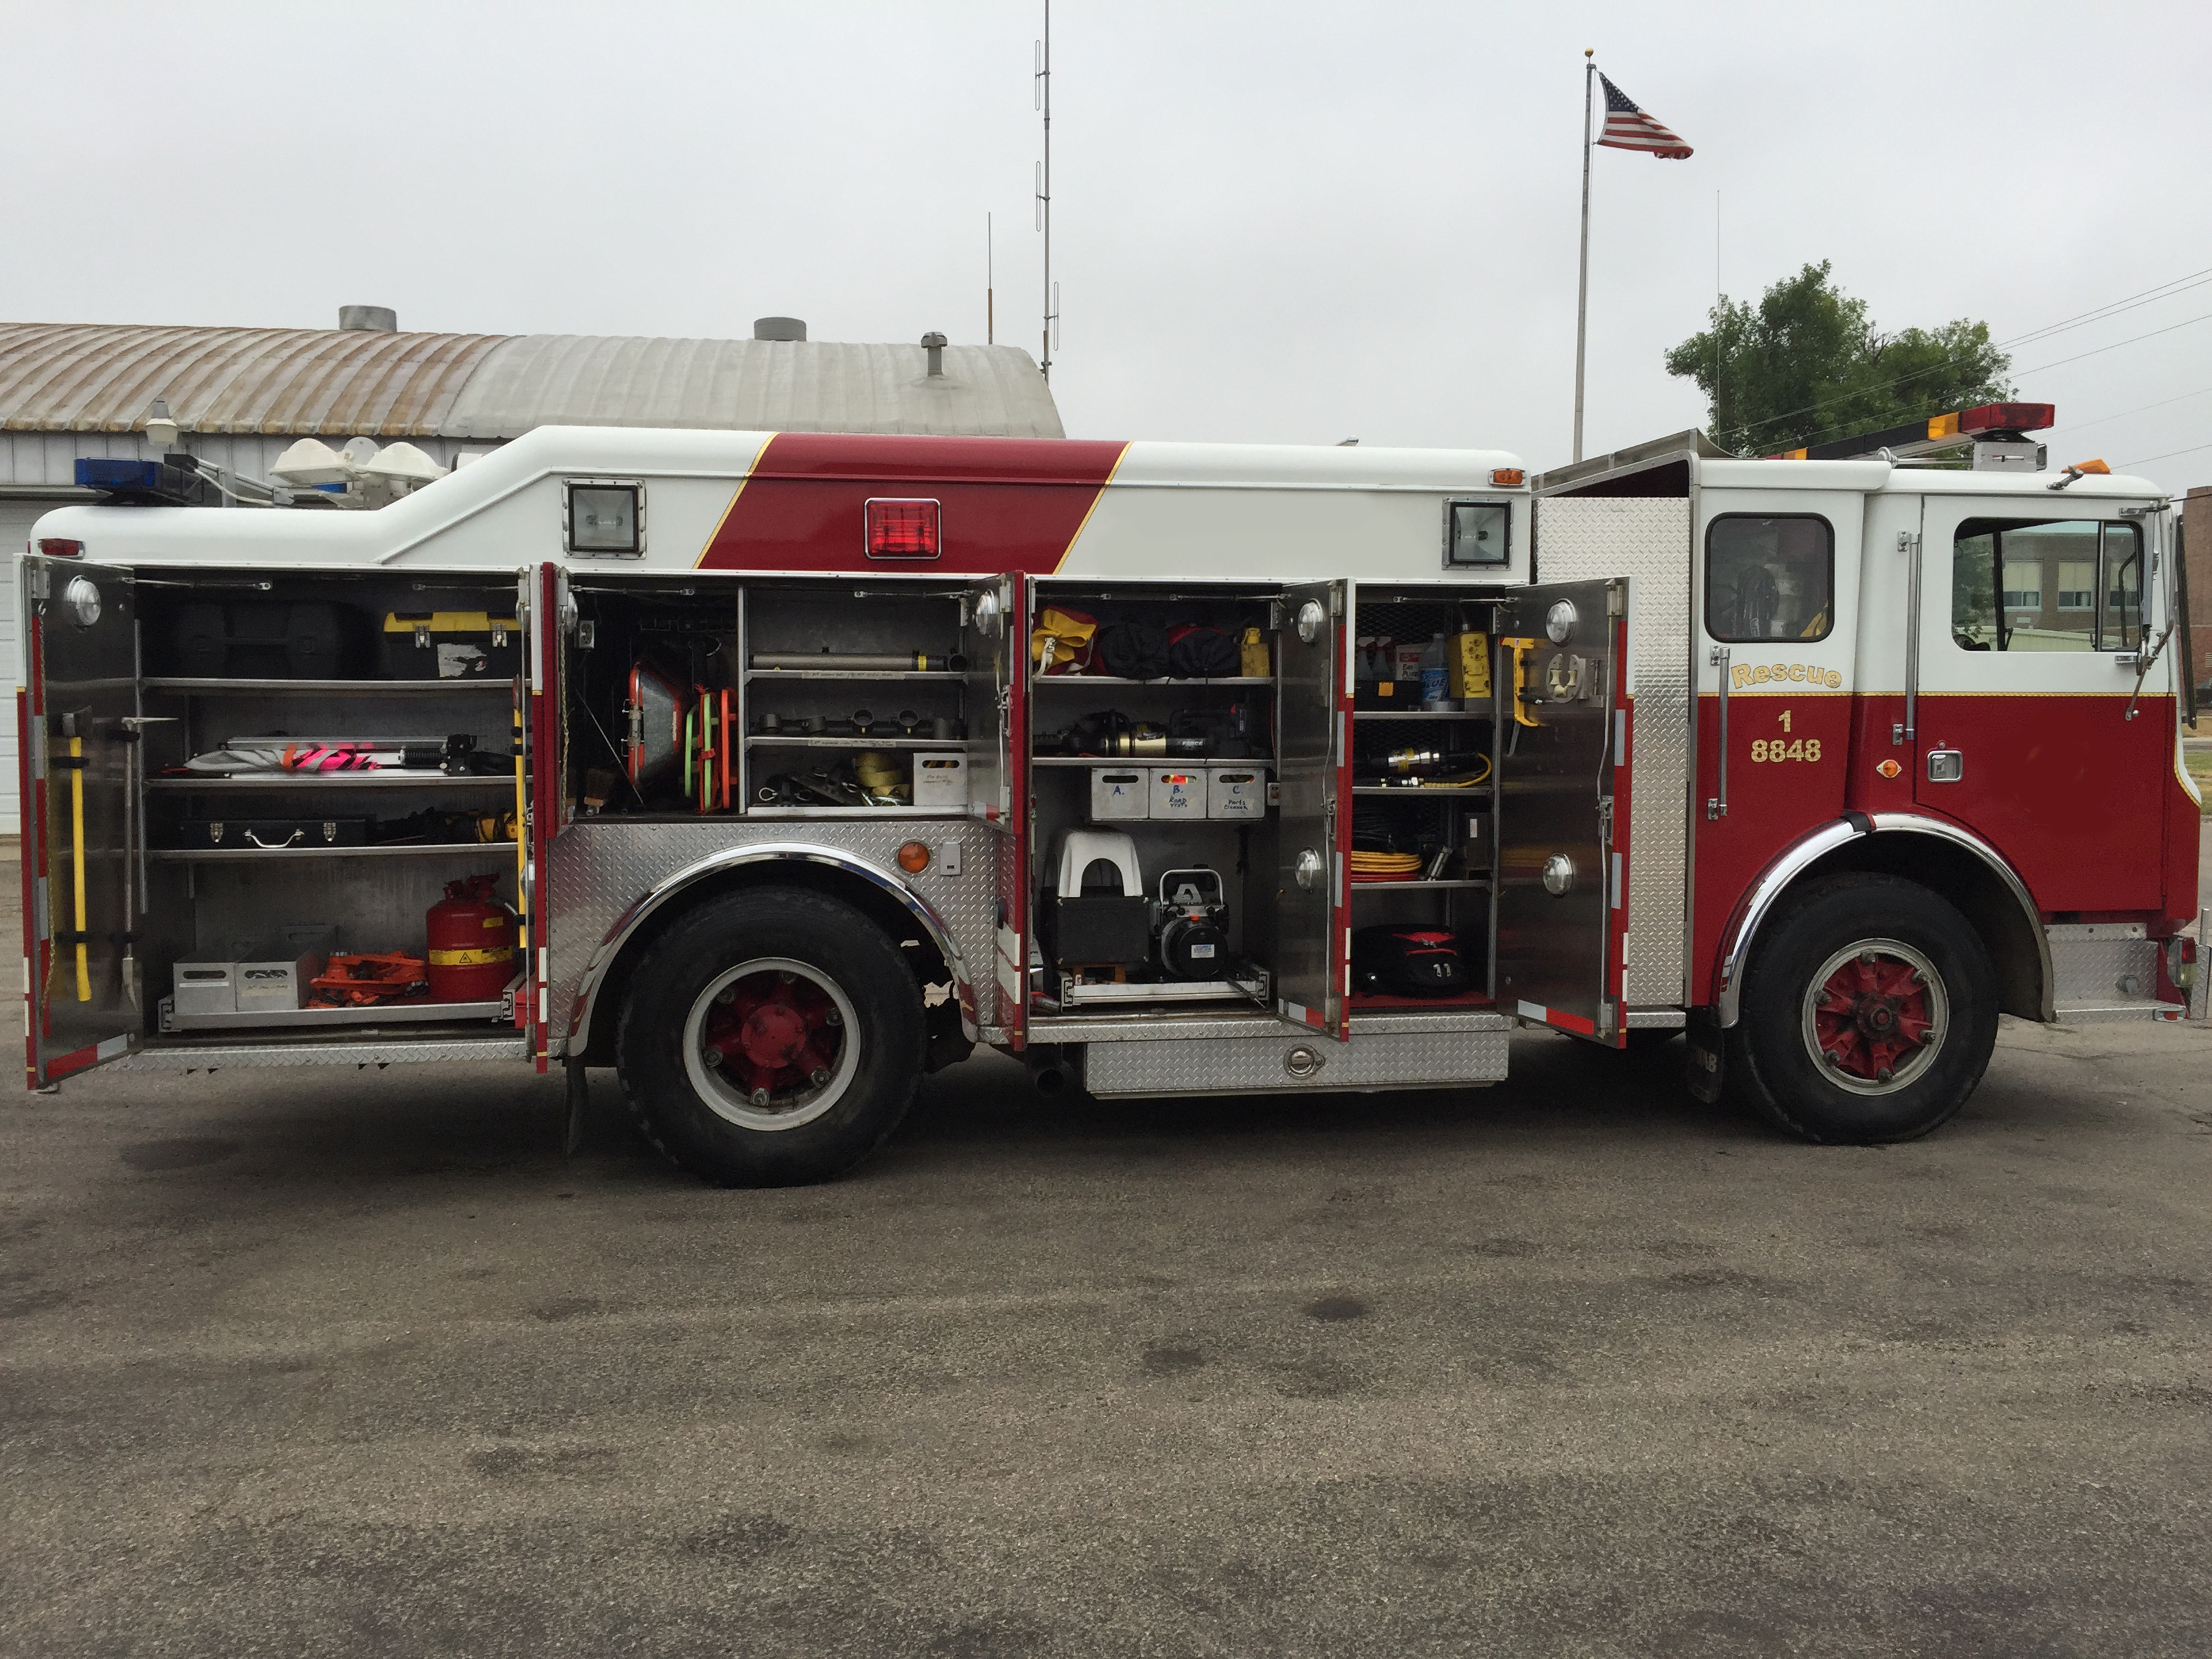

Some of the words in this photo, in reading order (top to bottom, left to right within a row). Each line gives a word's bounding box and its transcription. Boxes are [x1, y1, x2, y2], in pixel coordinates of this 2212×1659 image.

[1730, 663, 1842, 689] Rescue
[1778, 710, 1791, 733] 1
[1750, 739, 1822, 763] 8848
